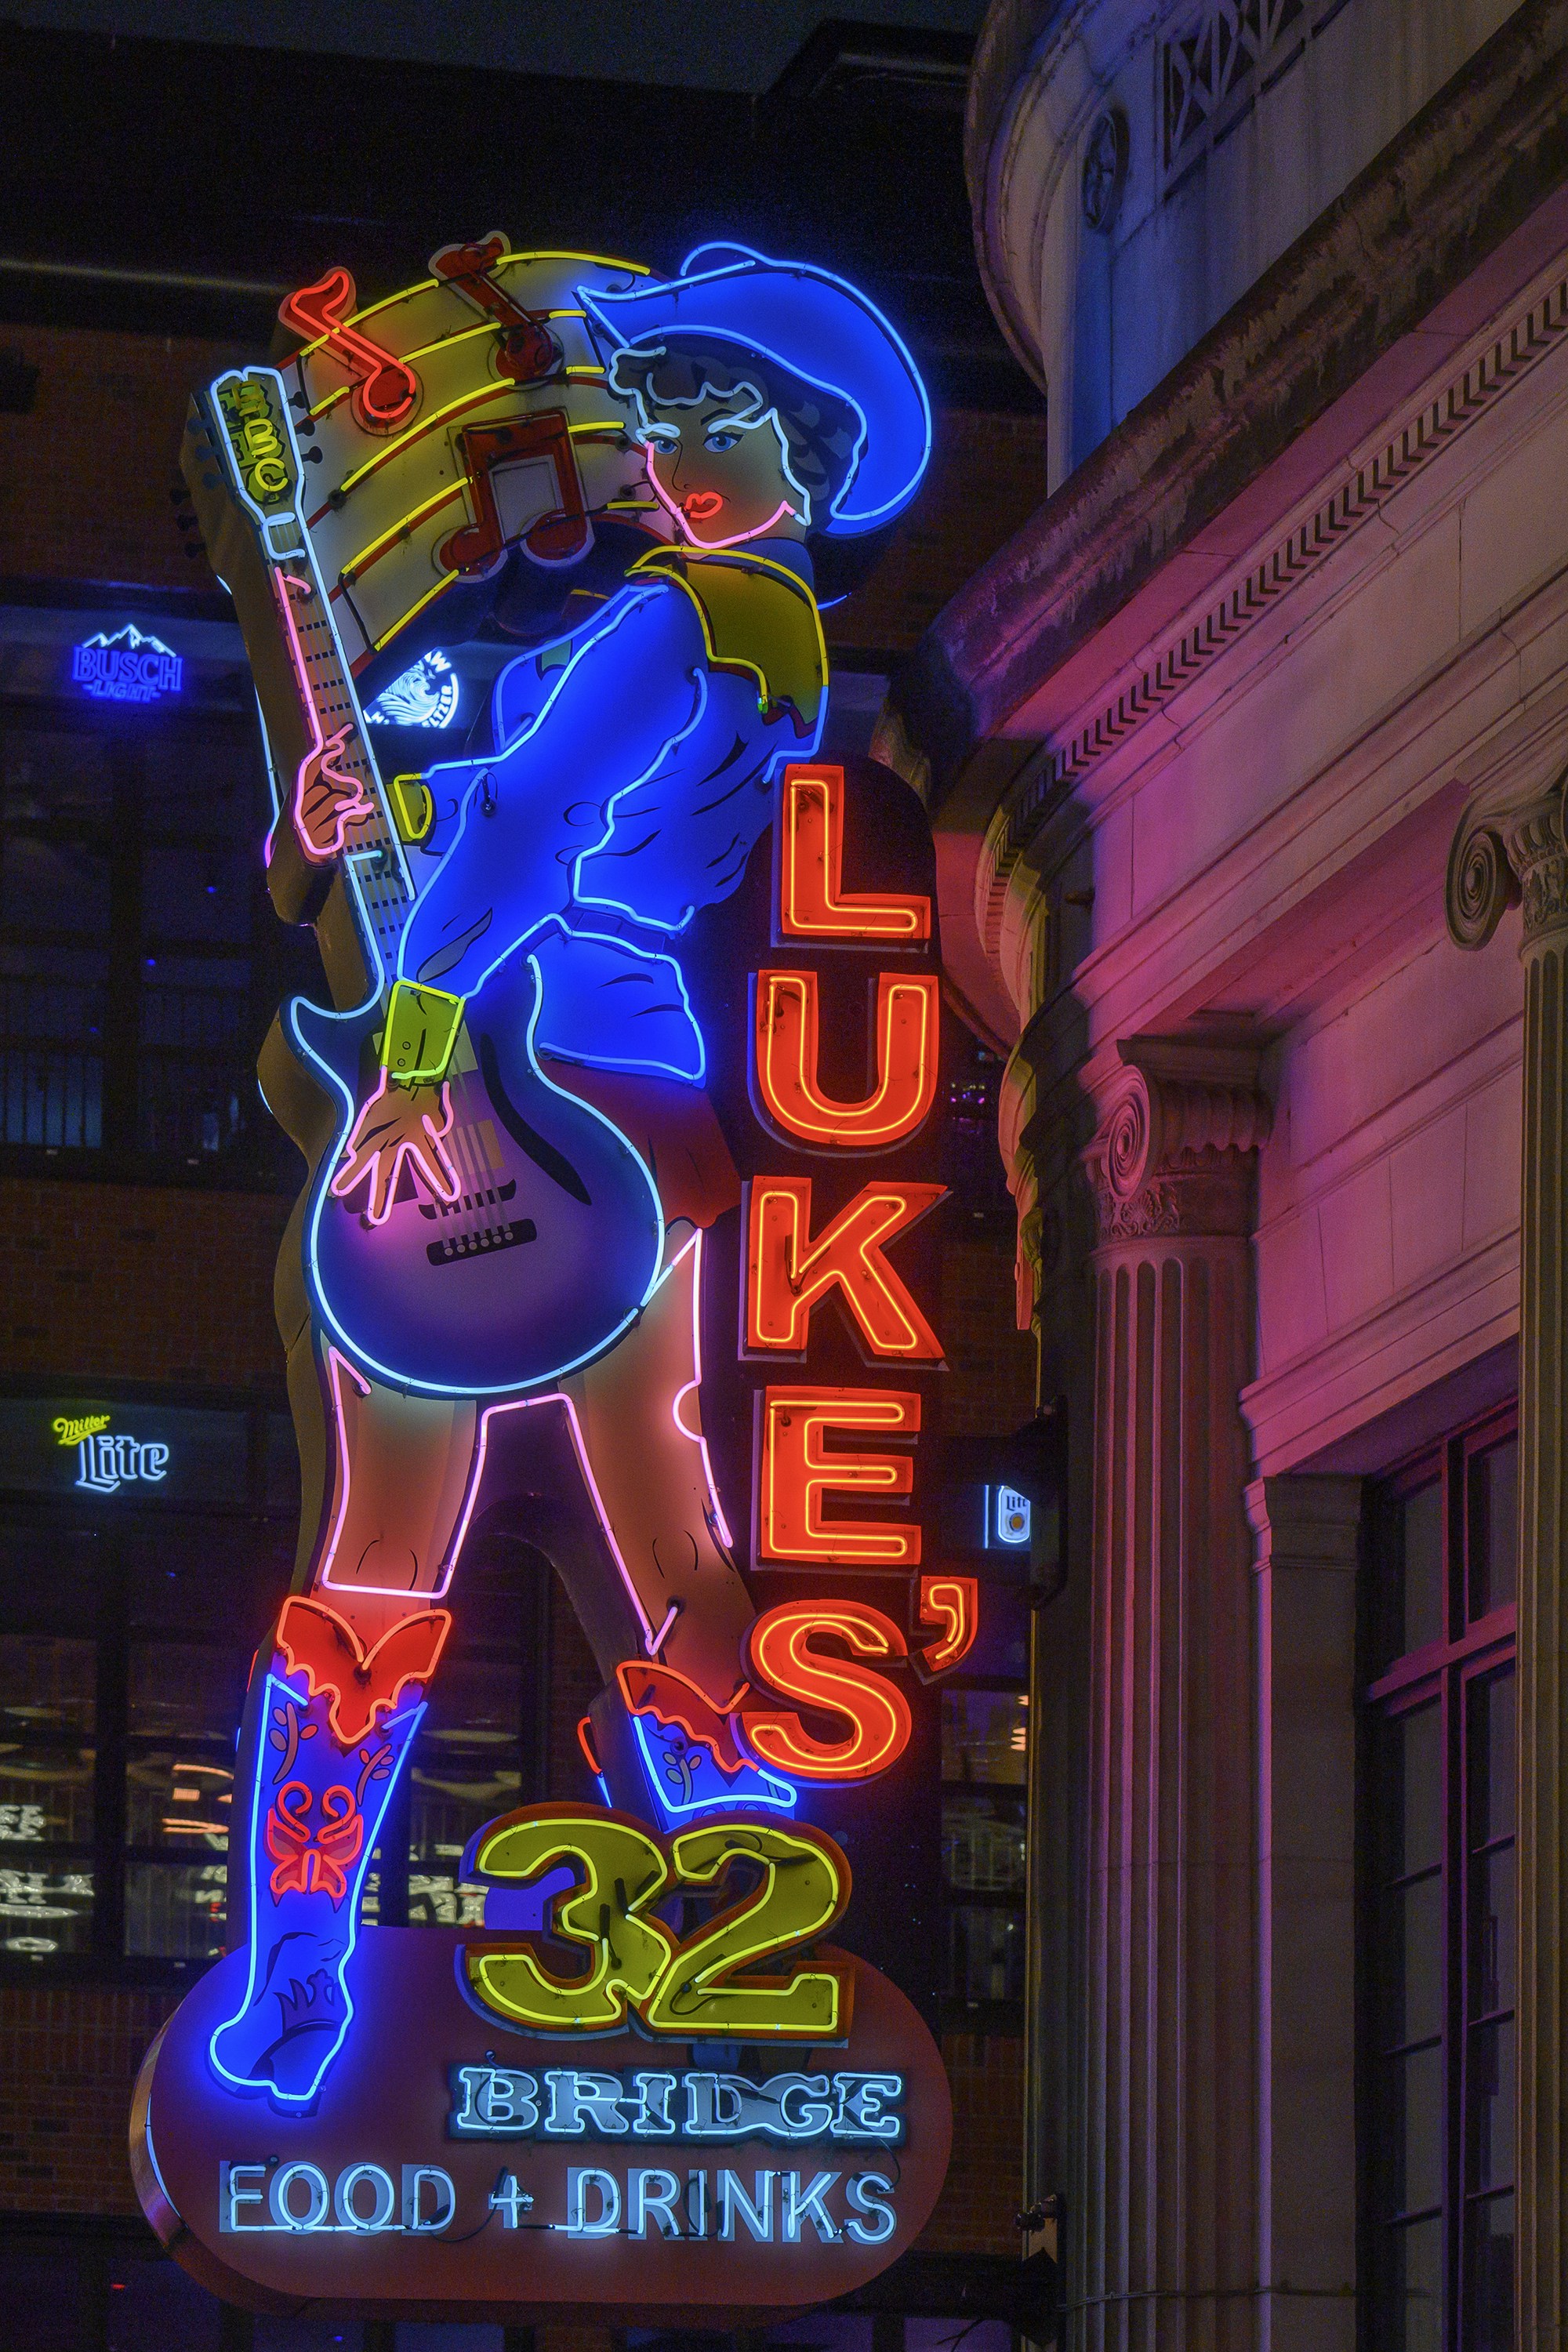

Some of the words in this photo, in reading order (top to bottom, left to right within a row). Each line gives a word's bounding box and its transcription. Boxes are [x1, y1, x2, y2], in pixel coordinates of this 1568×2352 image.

[72, 645, 183, 691] BUSCH
[742, 764, 978, 1780] LUKE'S
[53, 1415, 111, 1444] Miller
[75, 1434, 169, 1493] Lite
[466, 1802, 854, 2040] 32
[456, 2067, 903, 2138] BRIDGE
[219, 2161, 456, 2237] FOOD
[567, 2166, 898, 2245] DRINKS
